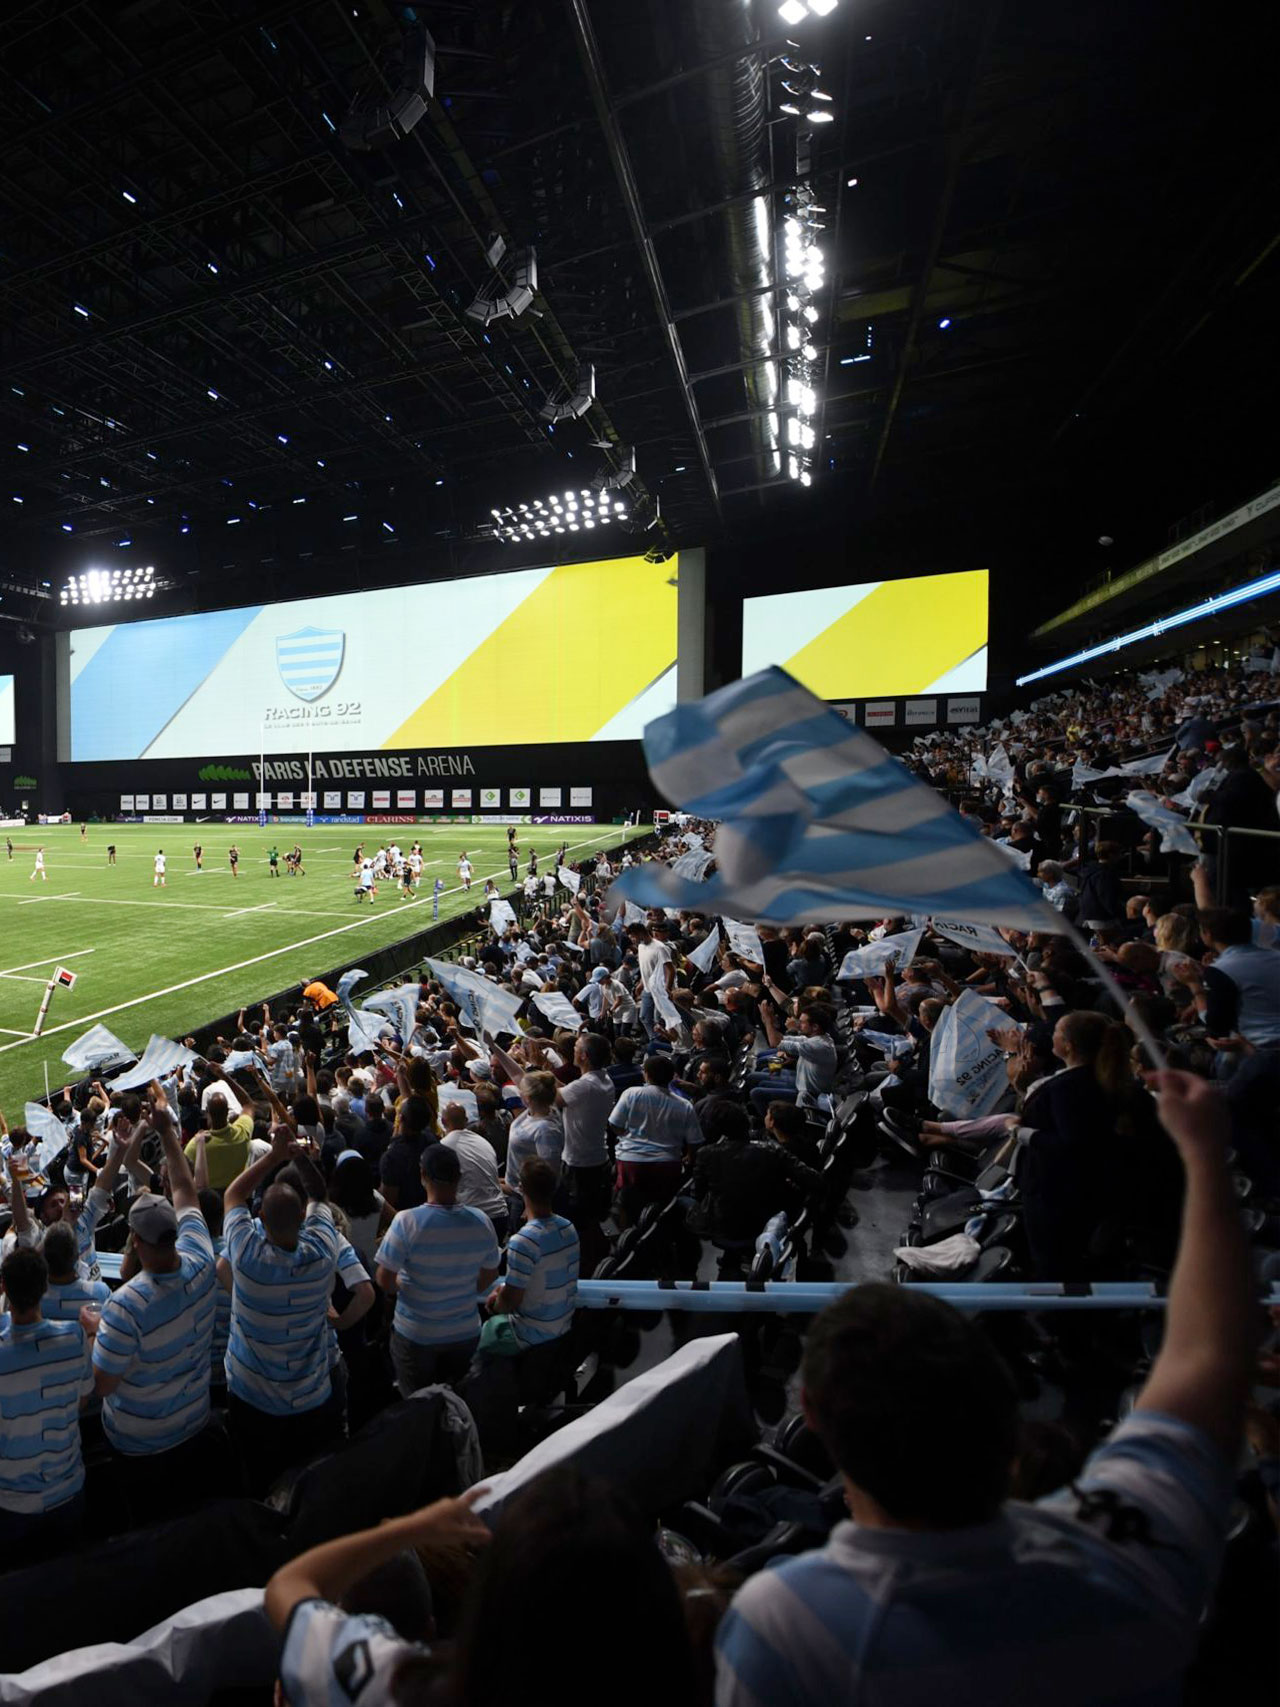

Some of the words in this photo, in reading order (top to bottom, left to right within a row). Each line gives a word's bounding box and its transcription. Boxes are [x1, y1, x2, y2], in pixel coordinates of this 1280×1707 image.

[265, 706, 331, 721] RACING
[337, 702, 362, 716] 92
[252, 761, 303, 781] PARIS
[305, 760, 326, 779] LA
[331, 757, 414, 779] DEFENSE
[417, 755, 476, 777] ARENA
